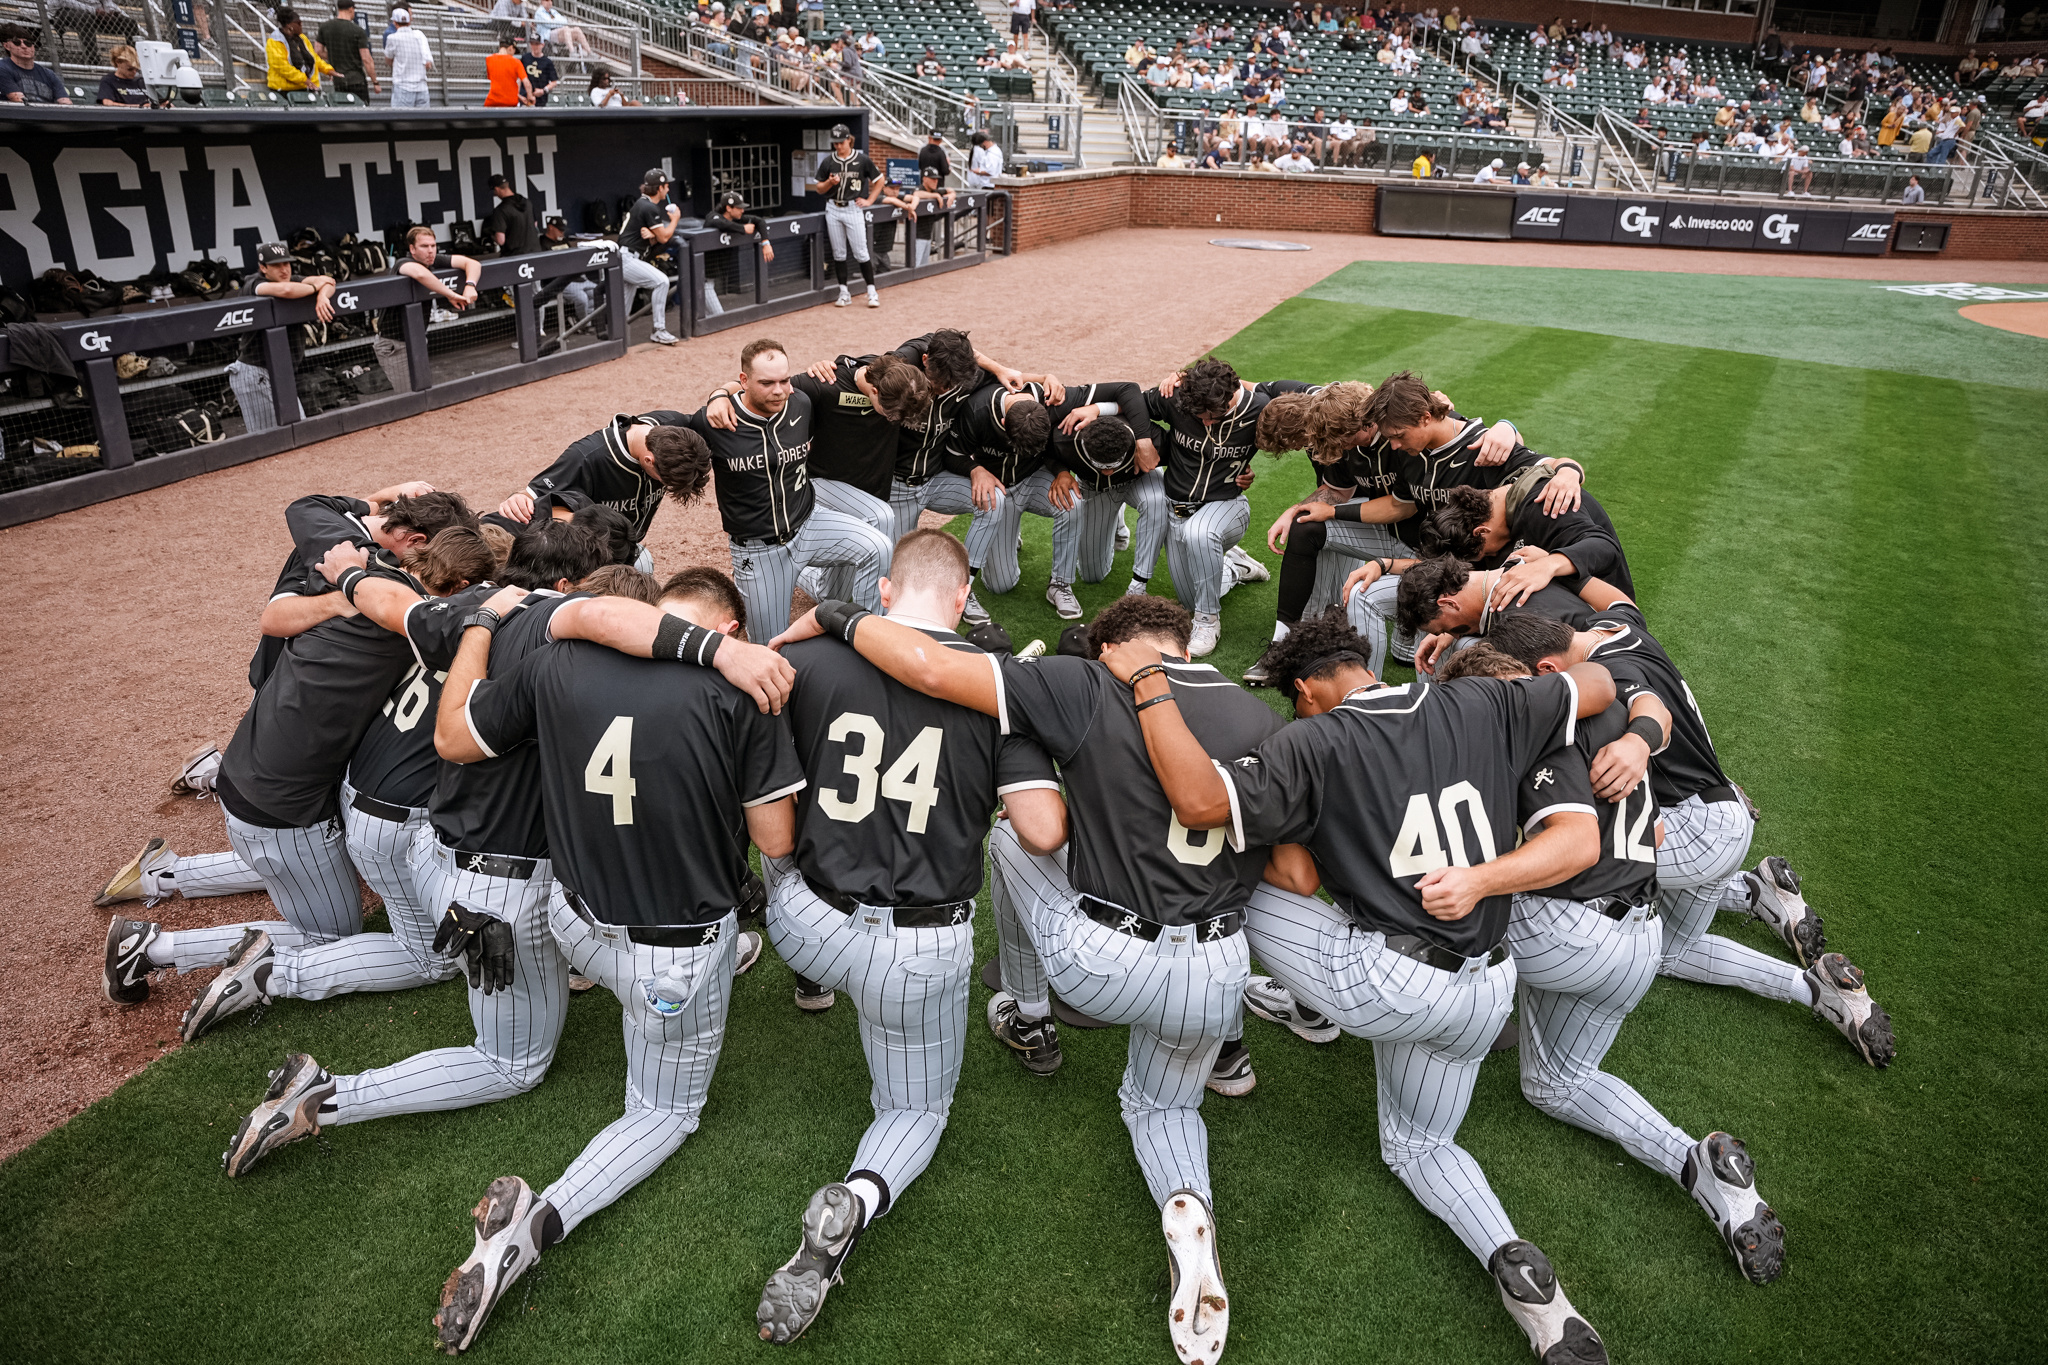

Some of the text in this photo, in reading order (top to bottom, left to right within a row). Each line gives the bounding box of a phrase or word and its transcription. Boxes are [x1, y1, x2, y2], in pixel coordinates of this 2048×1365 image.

[850, 179, 862, 191] 30
[1517, 207, 1565, 226] ACC
[1620, 206, 1660, 237] GT
[1688, 215, 1754, 232] Invesco QQQ
[1762, 213, 1800, 244] GT
[1848, 223, 1891, 241] ACC
[587, 251, 608, 266] ACC
[518, 263, 535, 279] GT
[337, 292, 358, 310] GT
[214, 308, 255, 332] ACC
[80, 331, 112, 353] GT
[845, 394, 867, 406] WAKE
[1174, 429, 1252, 460] WAKE FOREST
[727, 454, 765, 472] WAKE
[1374, 472, 1398, 489] FOR
[584, 715, 637, 826] 4
[817, 711, 945, 835] 34
[1389, 779, 1497, 879] 40
